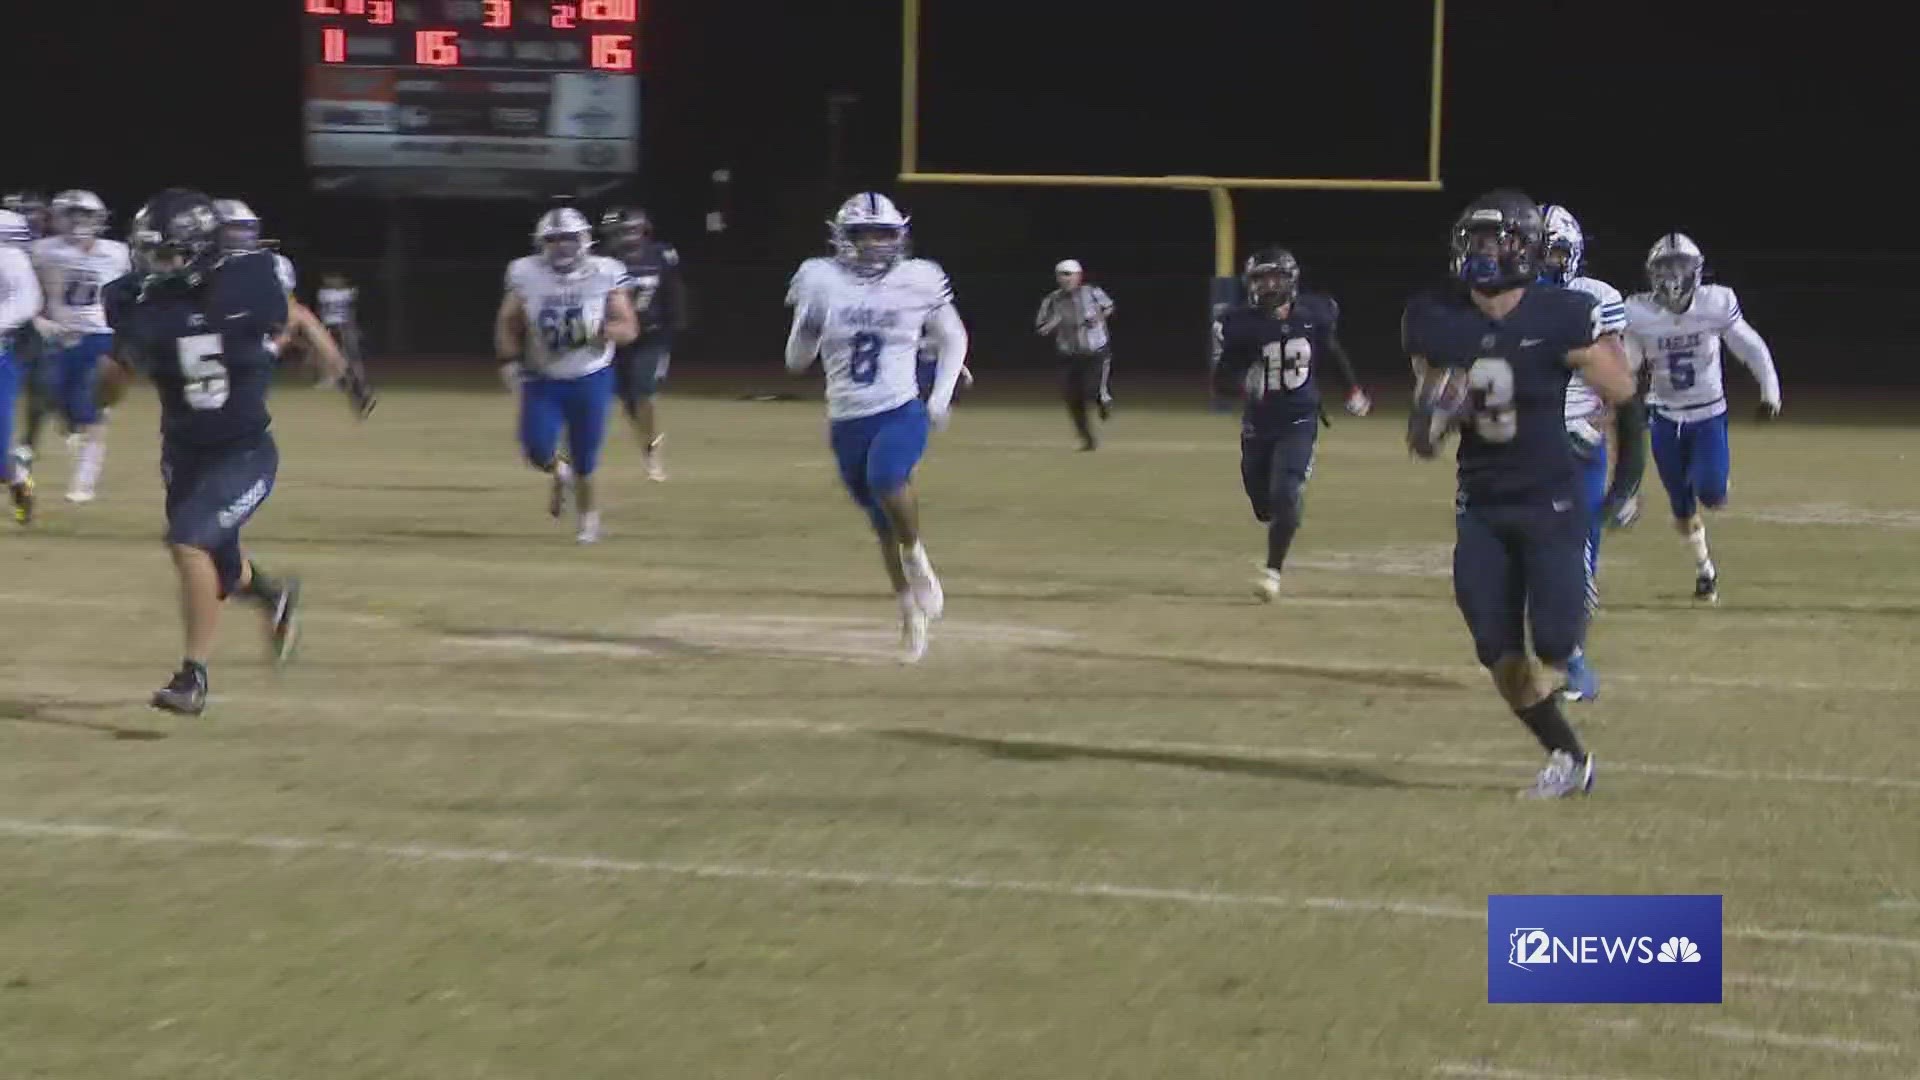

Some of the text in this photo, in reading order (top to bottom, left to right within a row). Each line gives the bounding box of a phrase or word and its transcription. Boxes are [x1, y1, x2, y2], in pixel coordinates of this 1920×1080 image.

[176, 333, 230, 410] 5
[1262, 337, 1312, 390] 13
[1667, 351, 1696, 391] 5
[1469, 358, 1517, 442] 3
